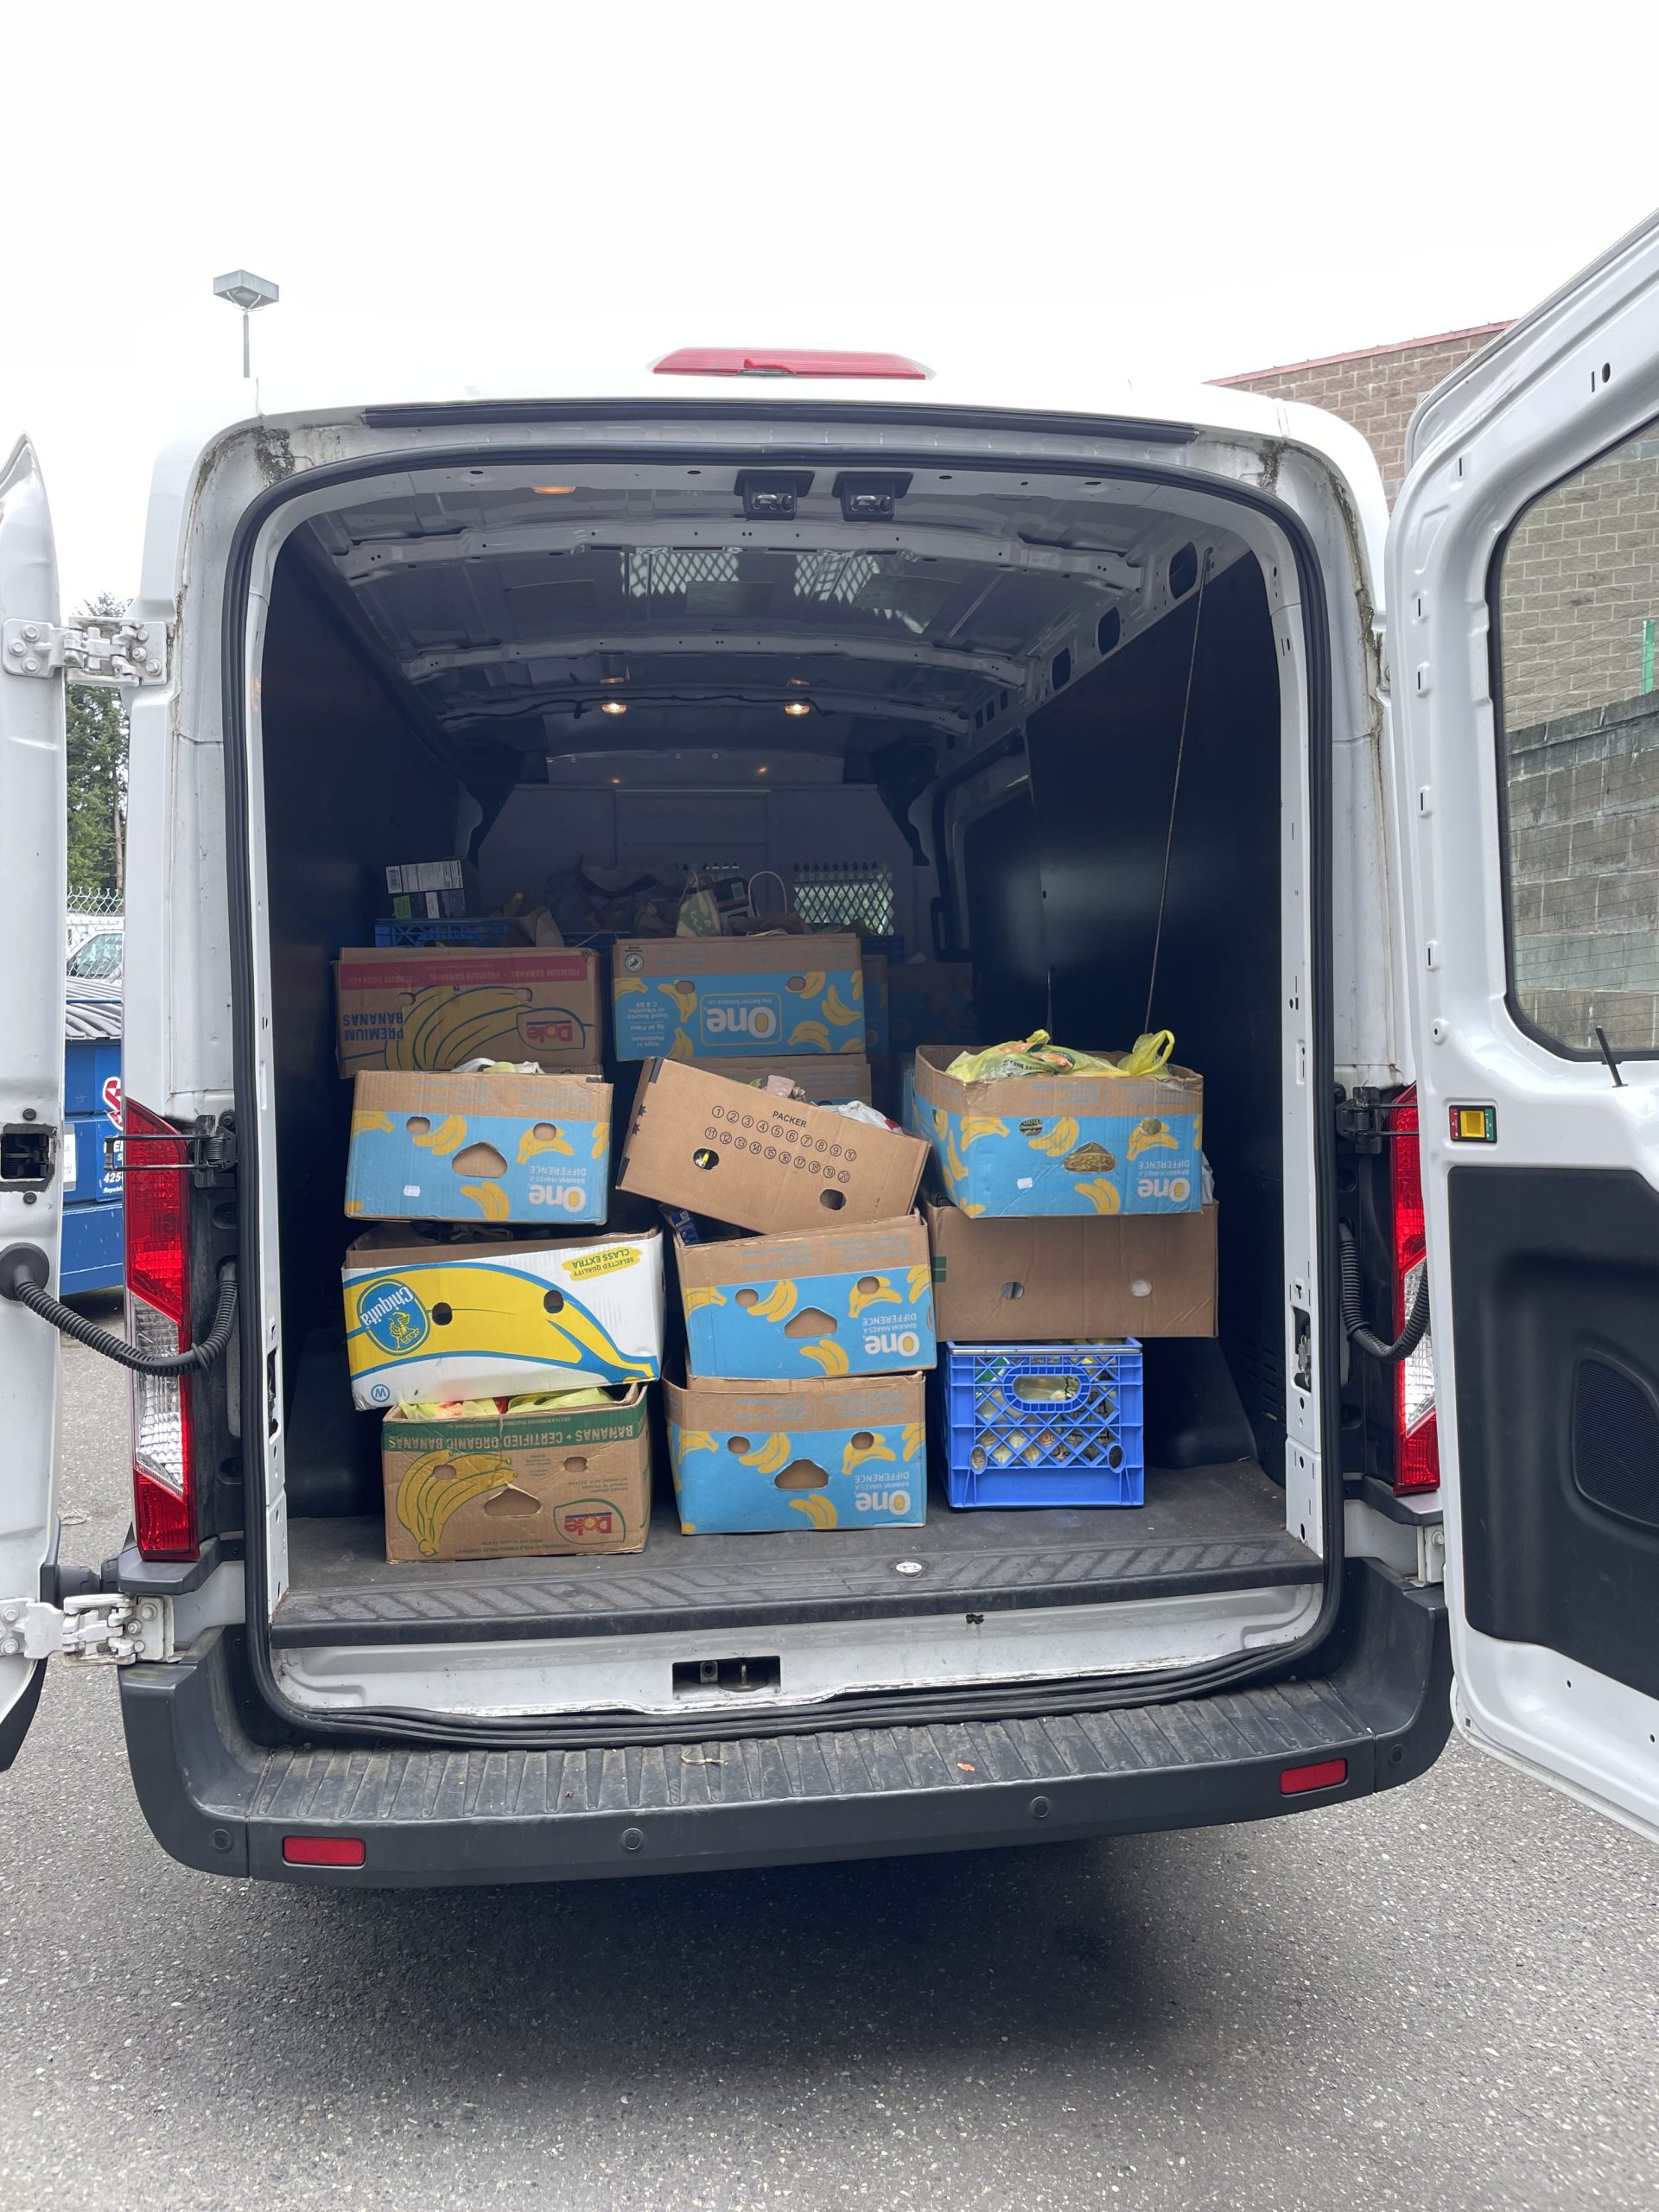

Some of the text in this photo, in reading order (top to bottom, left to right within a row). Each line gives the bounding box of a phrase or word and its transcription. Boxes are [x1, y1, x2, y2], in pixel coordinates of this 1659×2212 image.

[343, 1013, 404, 1027] BANANAS
[707, 1007, 776, 1039] One
[345, 1027, 404, 1041] PREMIUM
[526, 1026, 573, 1044] Dole
[772, 1110, 807, 1128] PACKER
[530, 1166, 587, 1177] DIFFERENCE
[1138, 1160, 1190, 1169] DIFFERENCE
[529, 1185, 586, 1212] One
[1138, 1178, 1190, 1202] One
[572, 1249, 630, 1268] CLASS EXTRA
[574, 1256, 634, 1276] SELECTED QUALITY
[359, 1287, 414, 1326] Chiquita
[862, 1313, 917, 1326] DIFFERENCE
[864, 1332, 919, 1357] One
[389, 1425, 633, 1450] BANANAS CERTIFIED ORGANIC BANANAS
[854, 1471, 910, 1484] DIFFERENCE
[855, 1490, 911, 1516] One
[565, 1519, 612, 1535] Dole
